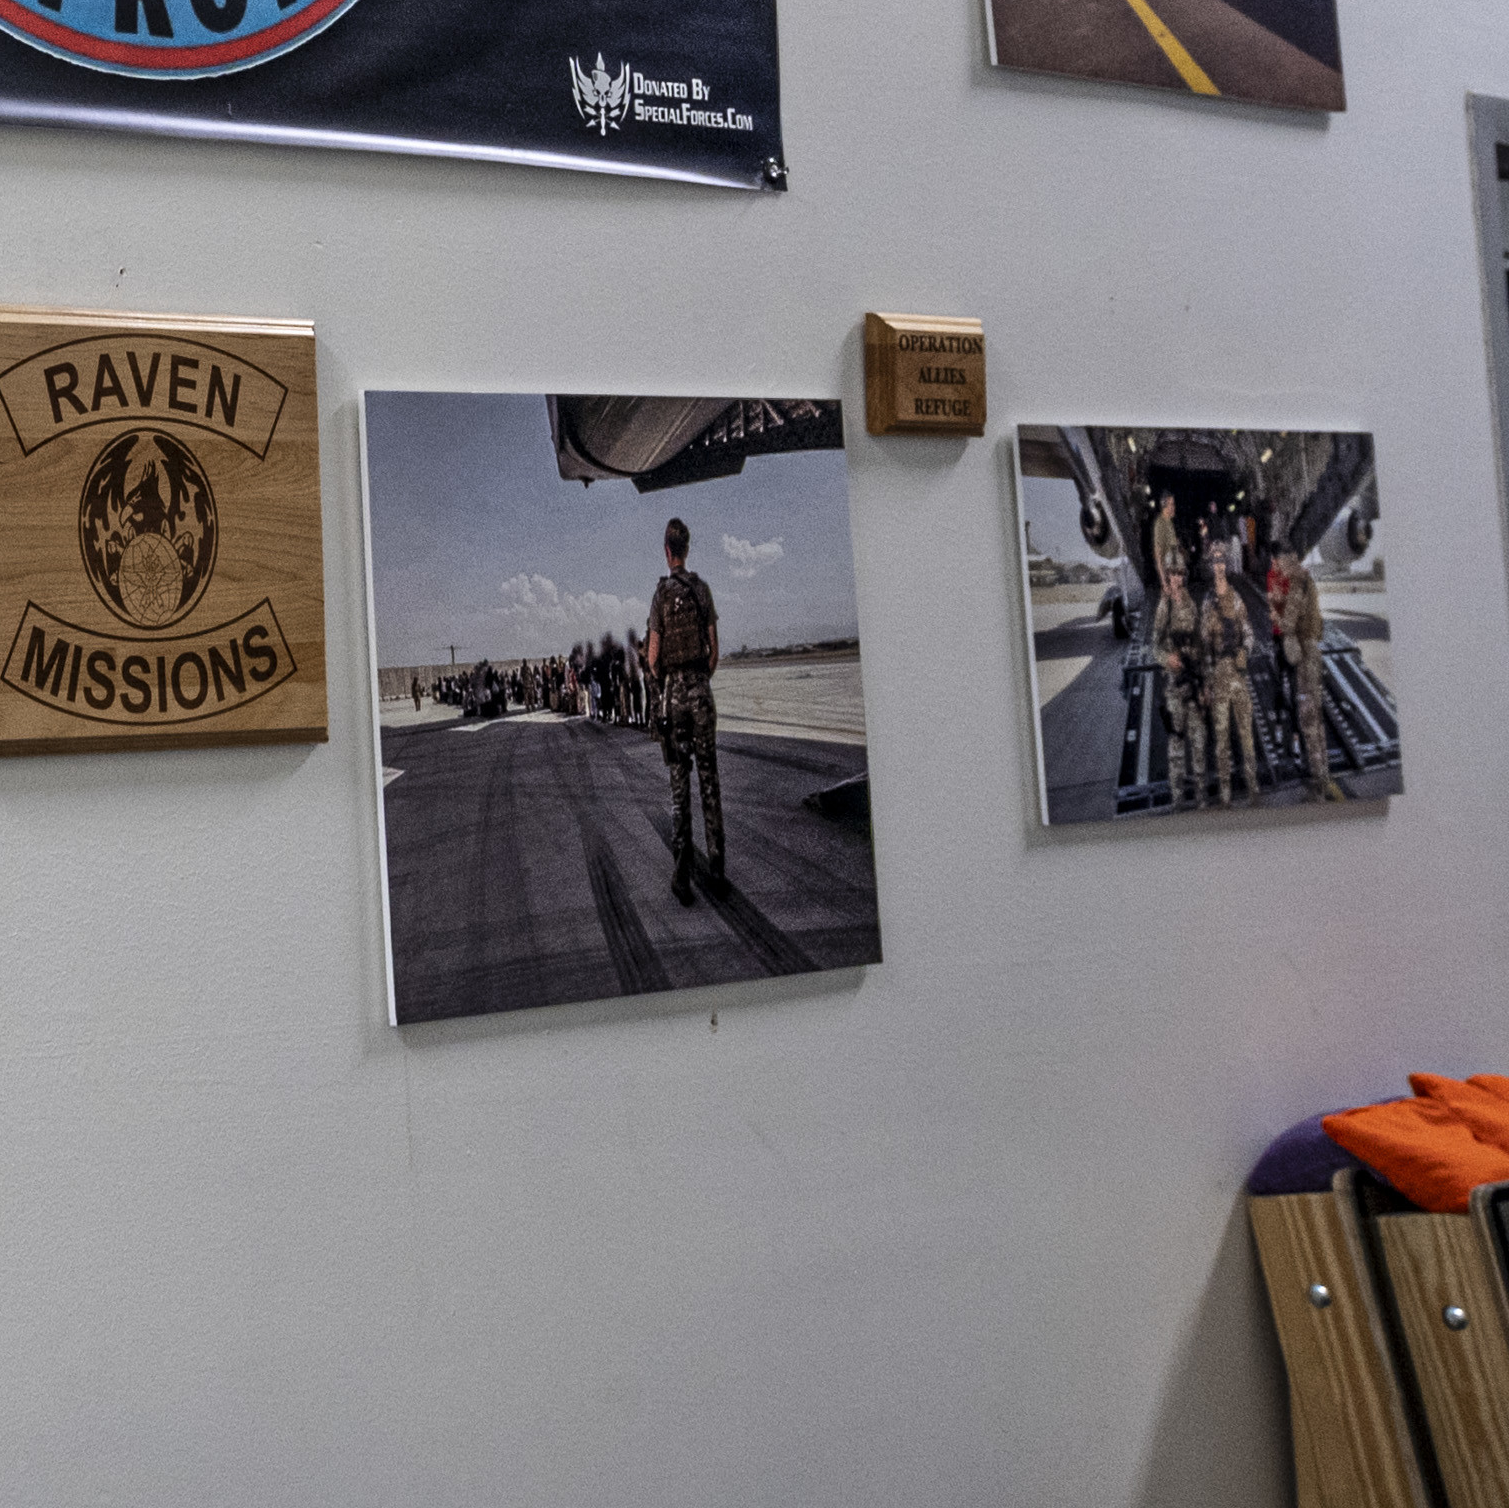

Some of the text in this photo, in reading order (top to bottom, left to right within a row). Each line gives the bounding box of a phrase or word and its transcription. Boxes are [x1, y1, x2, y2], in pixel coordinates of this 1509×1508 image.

[899, 334, 983, 354] OPERATION
[918, 366, 966, 385] ALLIES
[43, 351, 242, 428] RAVEN
[914, 398, 972, 417] REFUGE
[20, 624, 279, 714] MISSIONS
